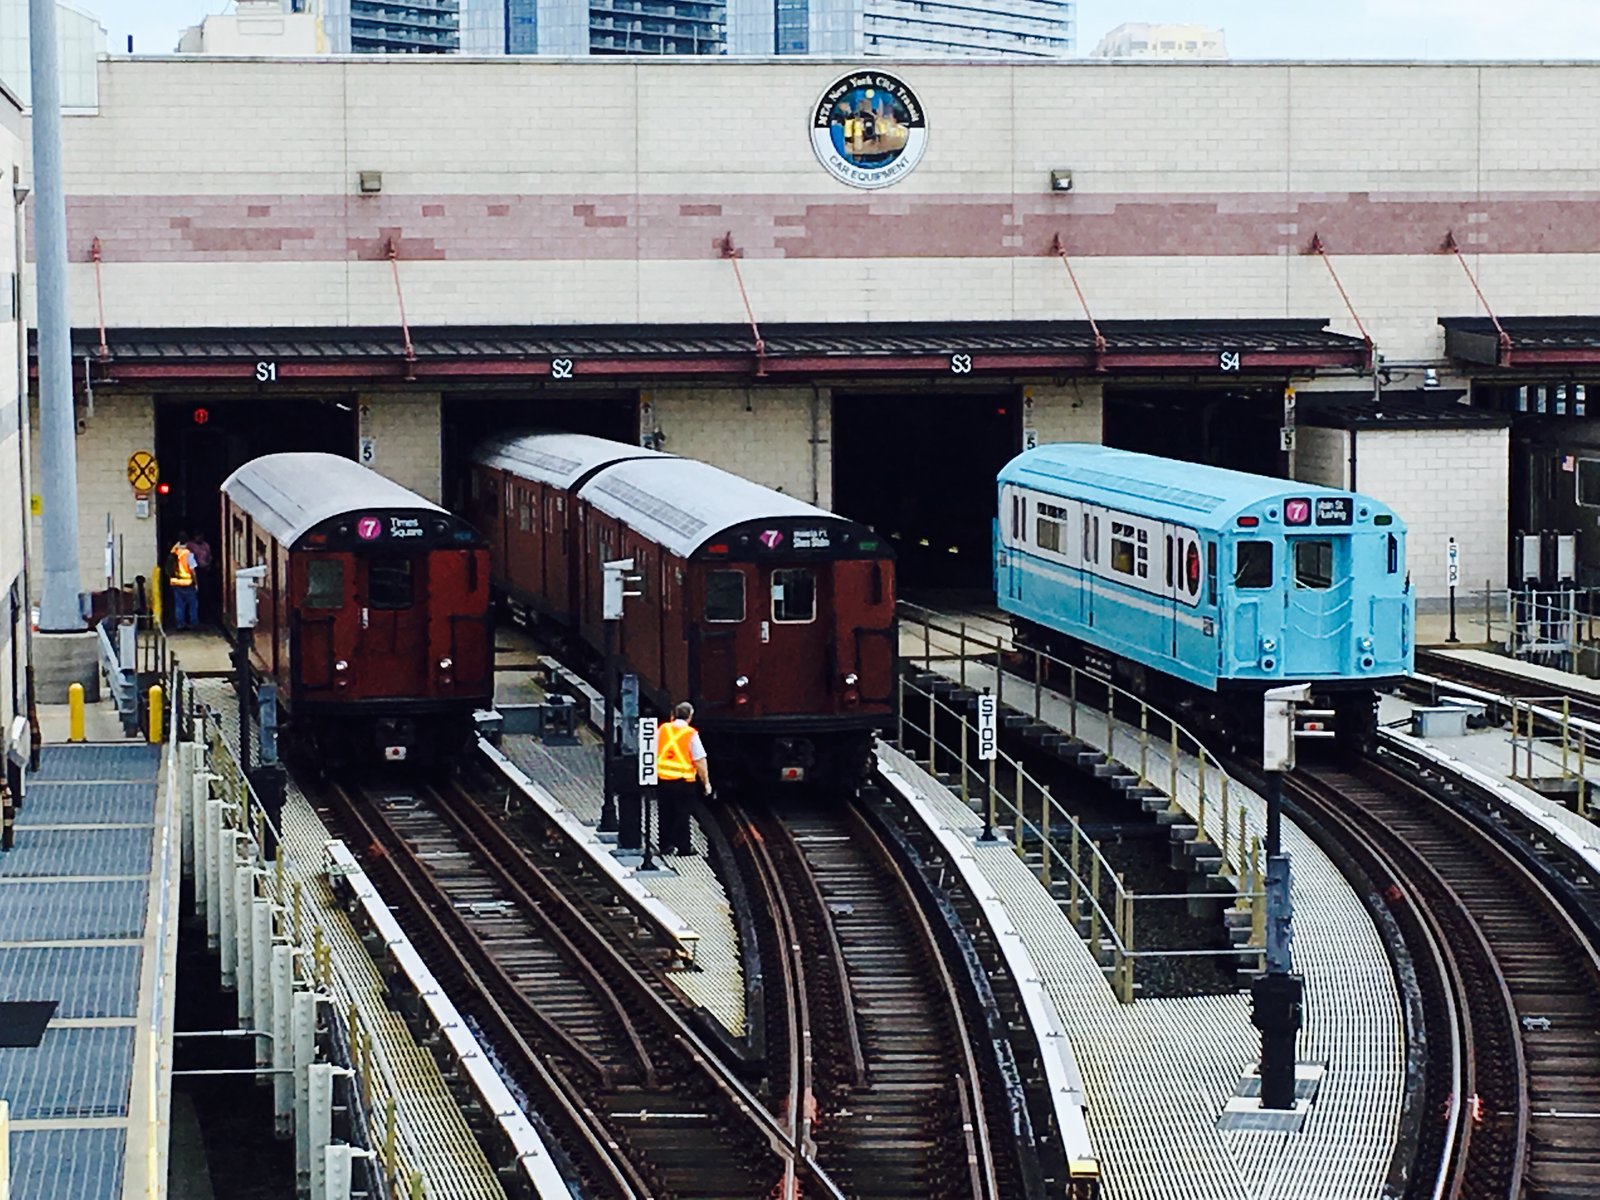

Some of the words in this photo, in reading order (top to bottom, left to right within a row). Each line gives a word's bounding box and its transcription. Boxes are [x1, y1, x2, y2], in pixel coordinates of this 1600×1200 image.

[818, 103, 833, 126] MTA
[829, 85, 848, 101] New
[849, 75, 873, 87] York
[875, 76, 896, 91] City
[896, 87, 920, 122] Transit
[829, 155, 850, 174] CAR
[851, 156, 910, 181] EQUIPMENT
[552, 358, 573, 378] S2
[951, 354, 971, 373] S3
[1220, 351, 1240, 370] S4
[256, 361, 276, 381] S1
[1027, 436, 1036, 450] 5
[1284, 433, 1293, 445] 5
[363, 446, 372, 461] 5
[1292, 504, 1304, 519] 7
[364, 521, 376, 537] 7
[390, 517, 419, 527] Times
[390, 527, 423, 538] Square
[765, 530, 778, 548] 7
[1449, 545, 1457, 582] STOP
[982, 699, 993, 756] STOP
[643, 722, 654, 780] STOP
